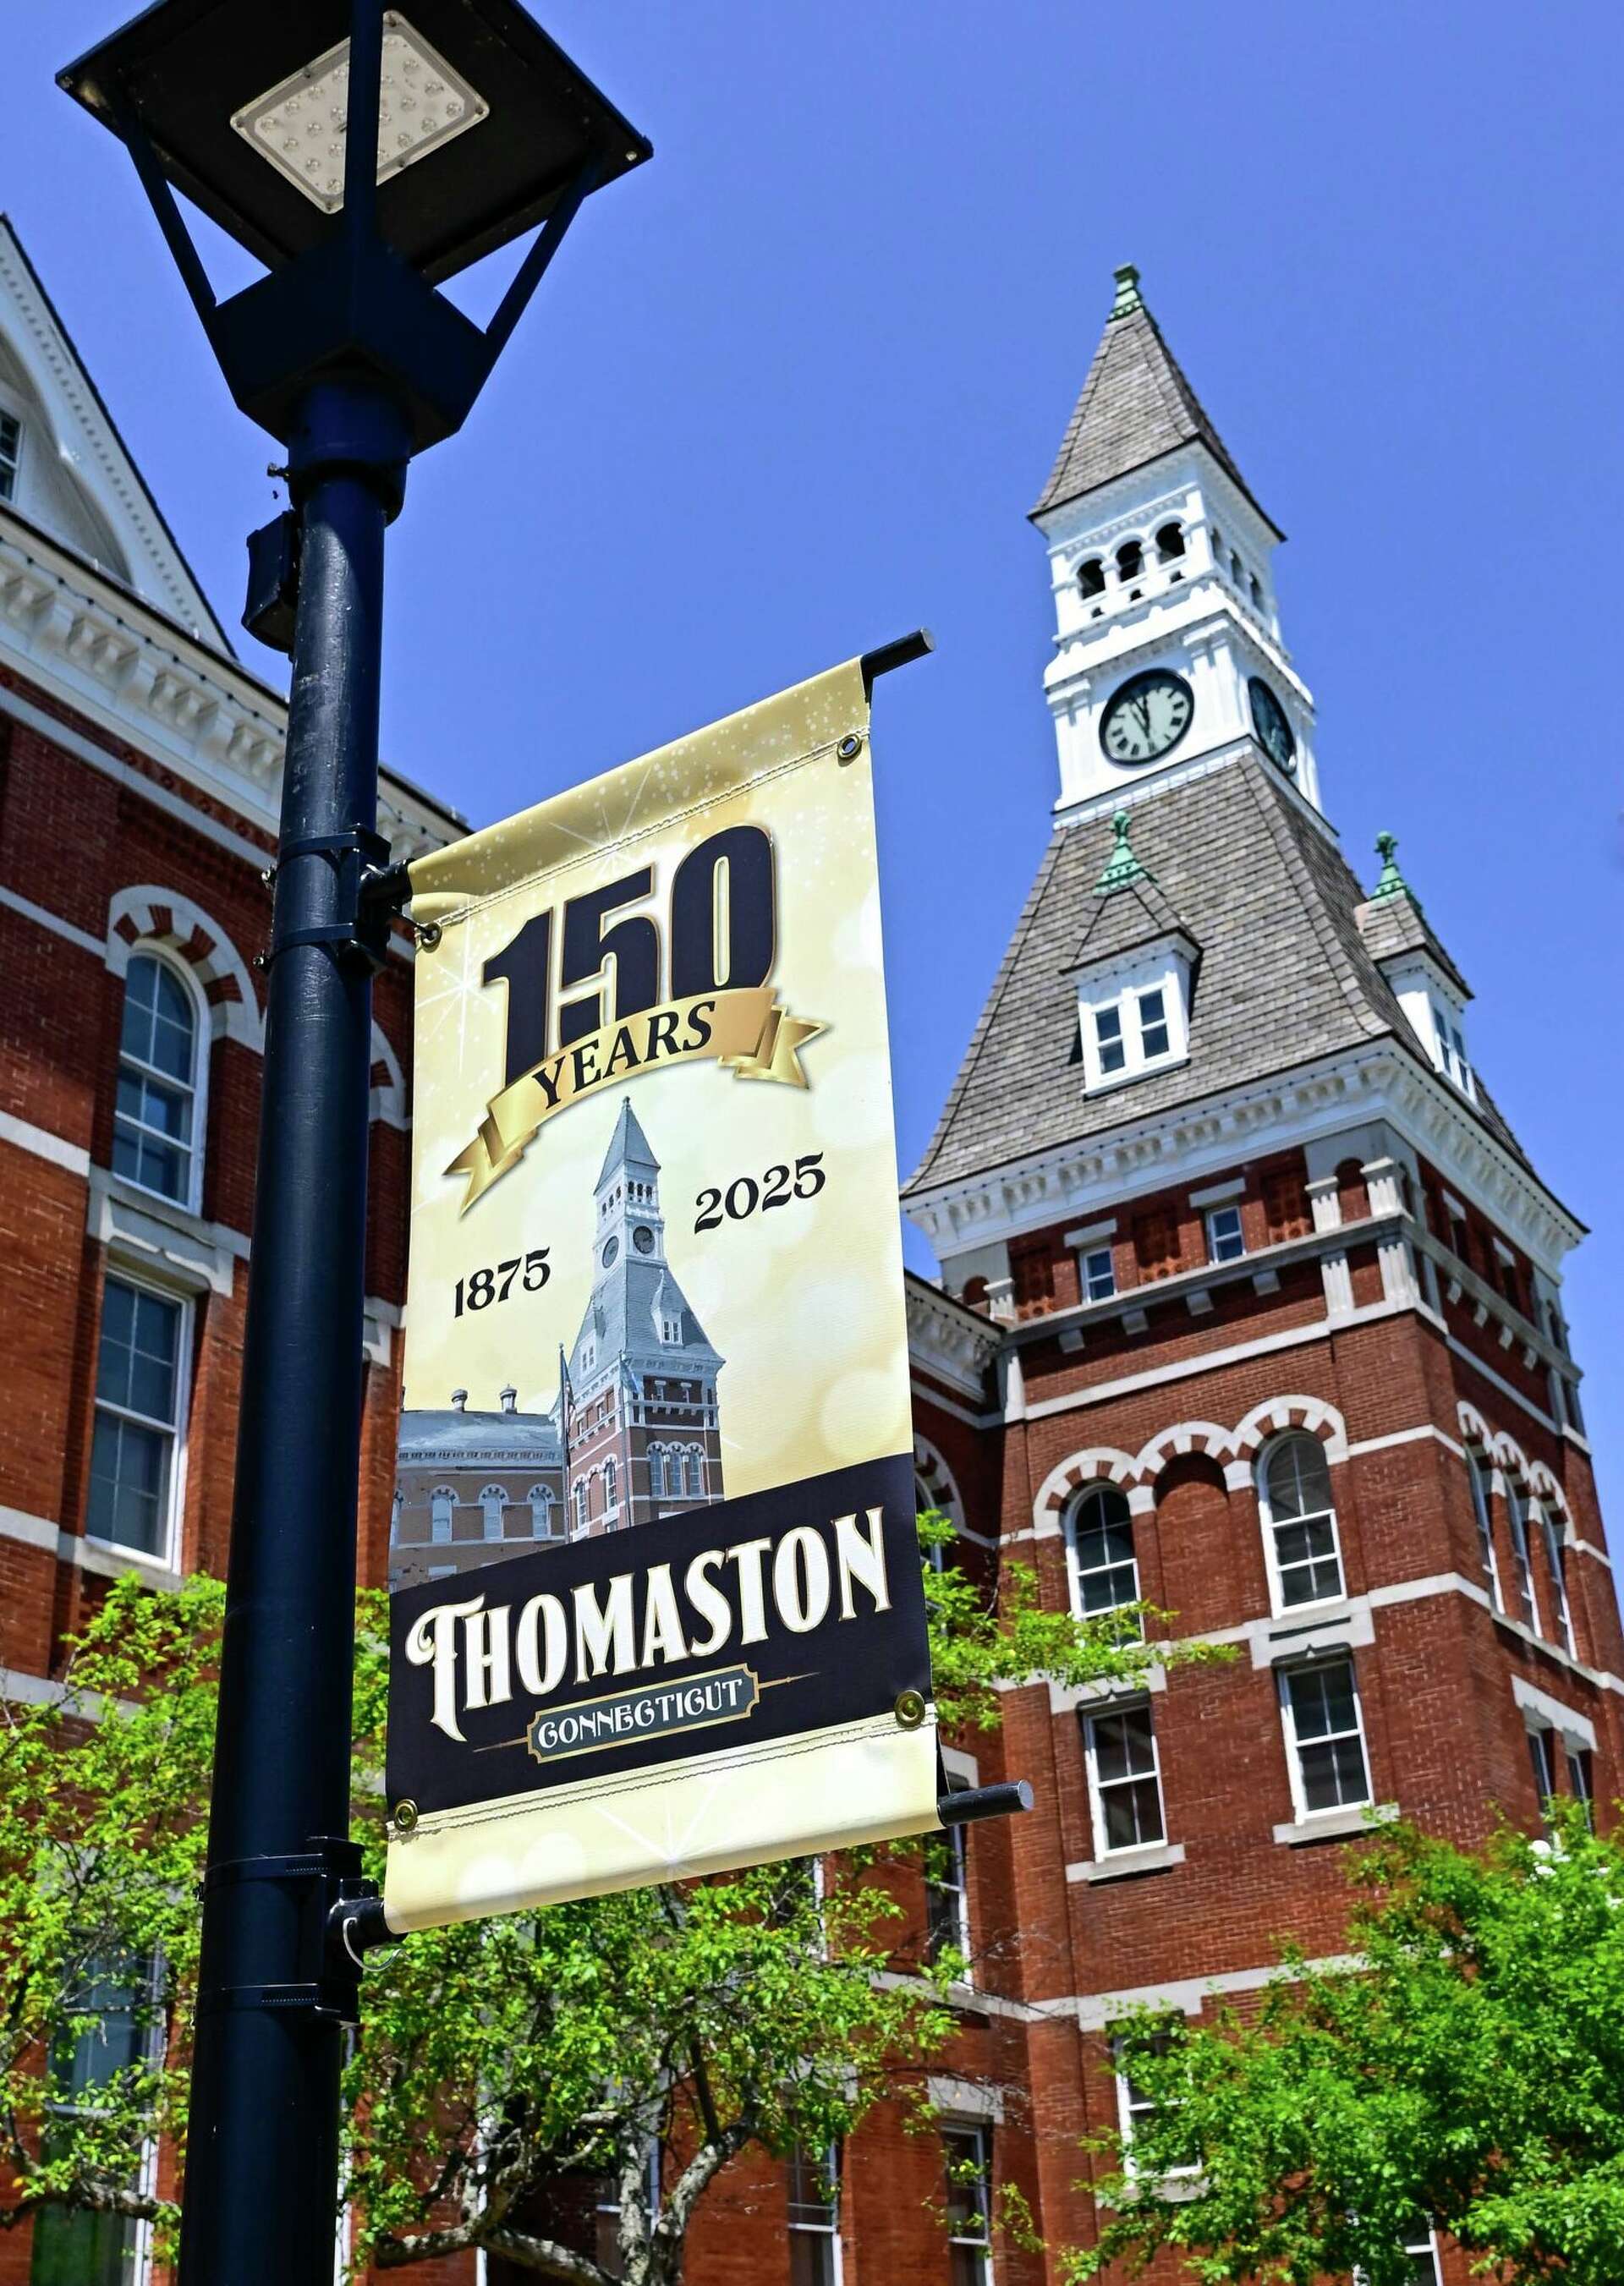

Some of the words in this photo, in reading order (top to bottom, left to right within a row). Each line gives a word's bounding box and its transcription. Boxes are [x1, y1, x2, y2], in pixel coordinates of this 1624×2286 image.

[482, 824, 778, 1086] 150
[531, 1000, 716, 1110] YEARS
[694, 1152, 826, 1235] 2025
[454, 1247, 551, 1318] 1875
[405, 1507, 892, 1742] THOMASTON
[537, 1678, 743, 1750] CONNECTICUT
